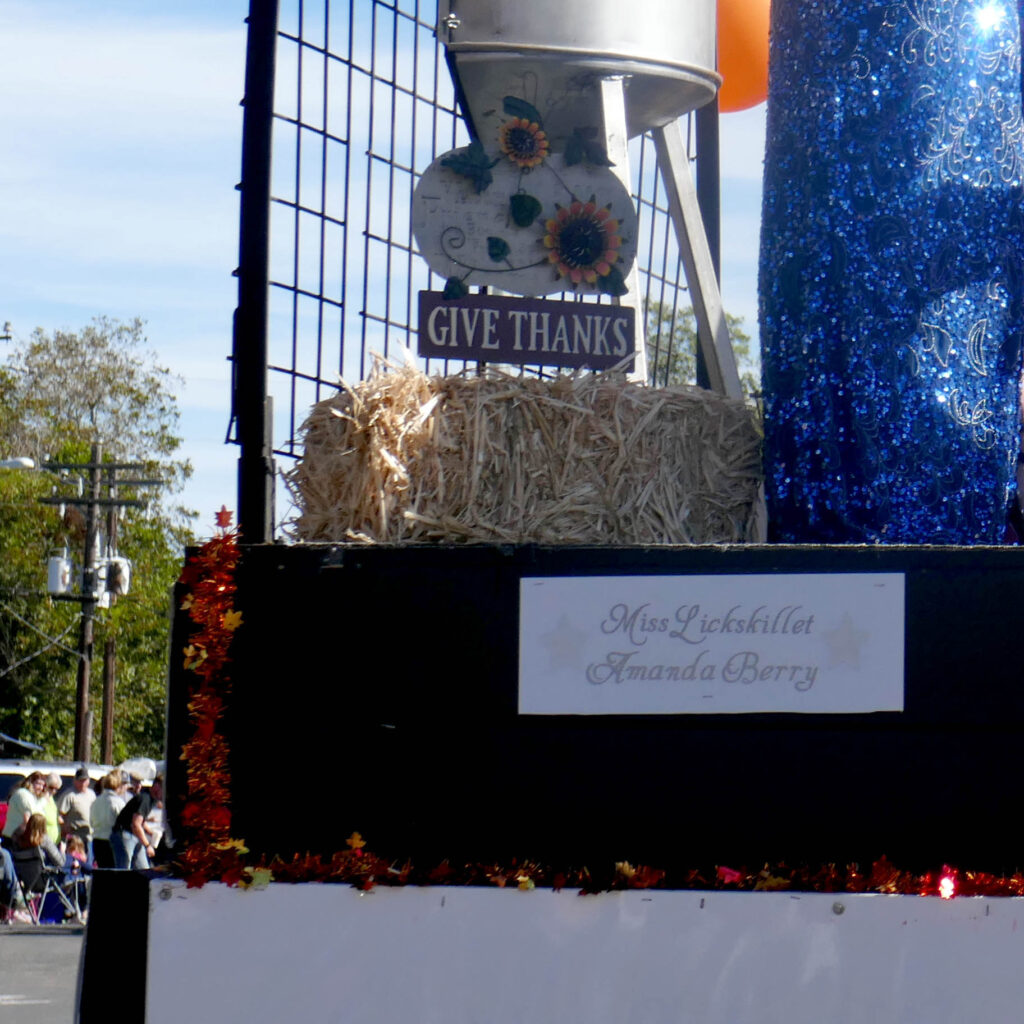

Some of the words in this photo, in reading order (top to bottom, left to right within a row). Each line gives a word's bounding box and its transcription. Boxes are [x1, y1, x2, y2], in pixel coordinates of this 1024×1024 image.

[427, 305, 500, 350] GIVE
[508, 308, 628, 358] THANKS
[600, 603, 669, 646] Miss
[669, 603, 815, 645] Lickskillet
[585, 650, 716, 686] Amanda
[721, 650, 819, 692] Berry
